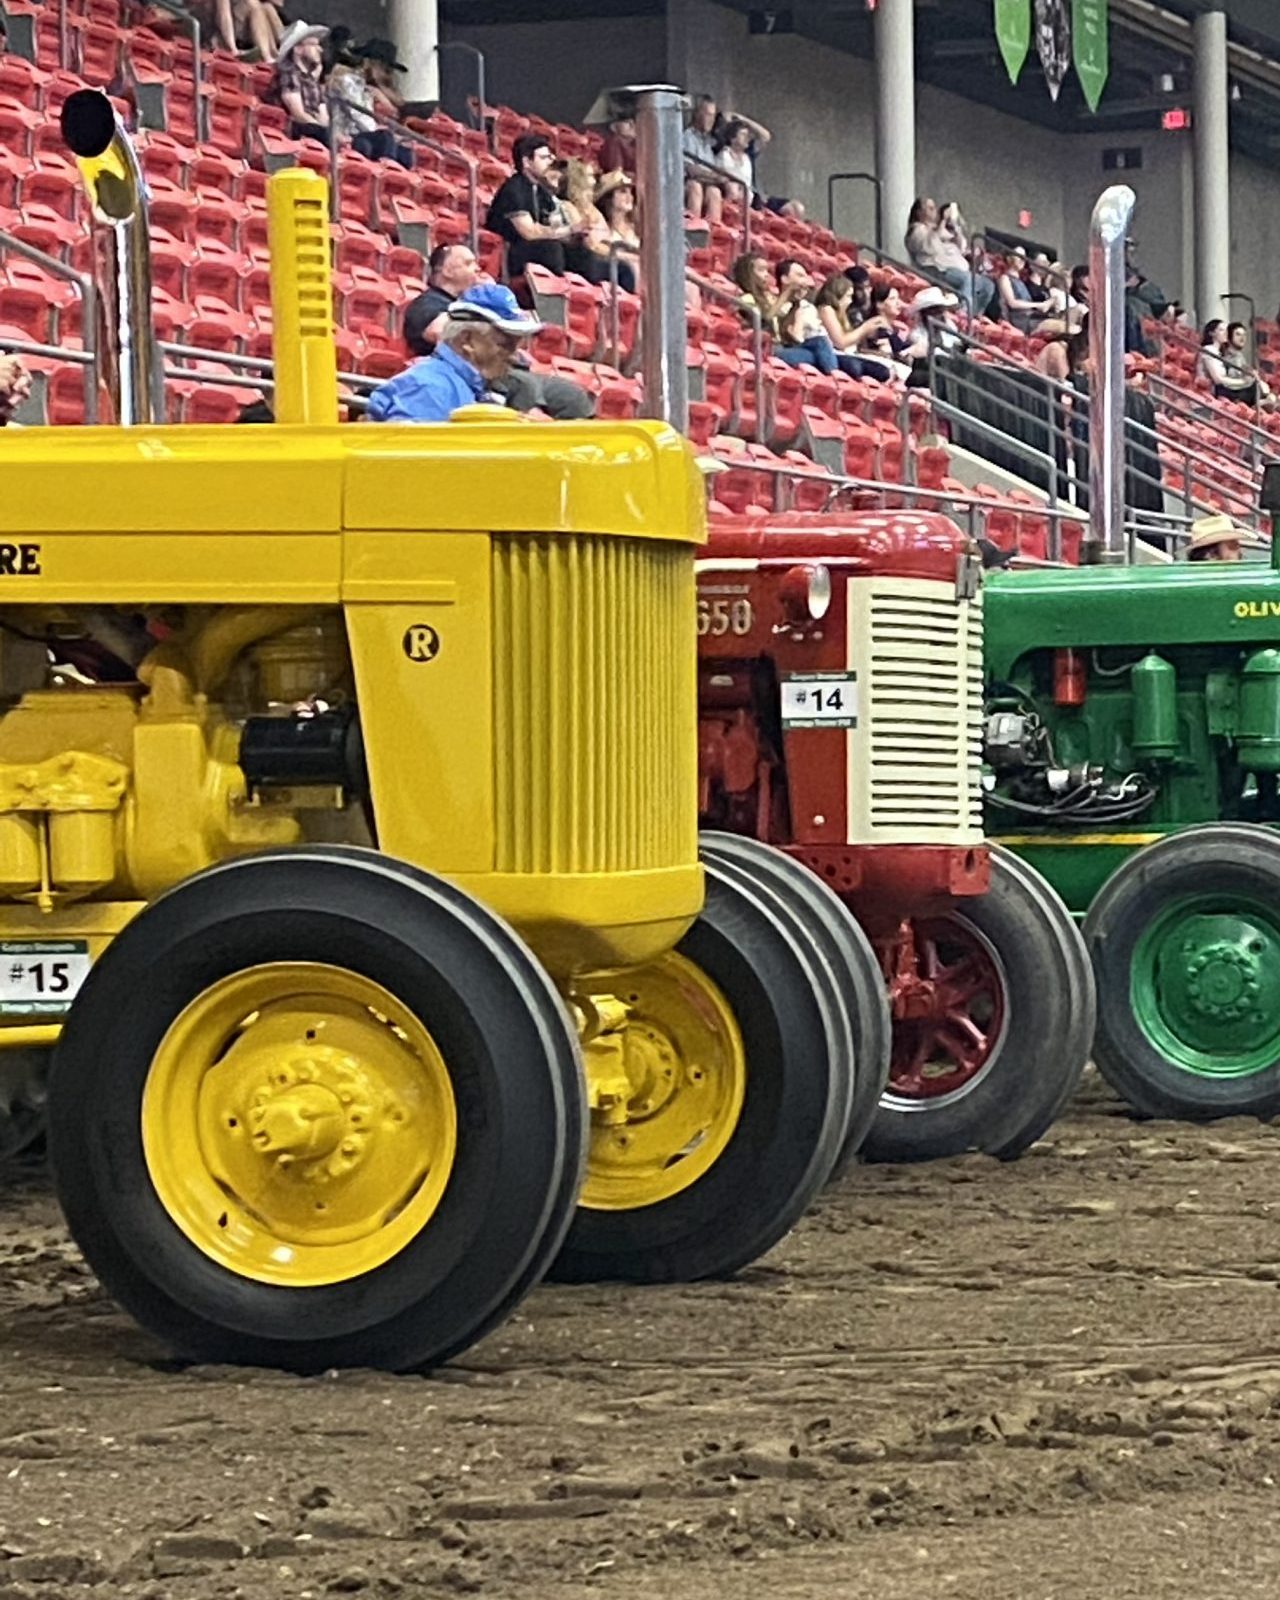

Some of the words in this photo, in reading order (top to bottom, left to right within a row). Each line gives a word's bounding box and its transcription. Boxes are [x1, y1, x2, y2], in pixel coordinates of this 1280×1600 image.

[697, 599, 753, 635] 650
[409, 627, 433, 658] R
[795, 687, 844, 712] #14
[8, 962, 70, 993] #15
